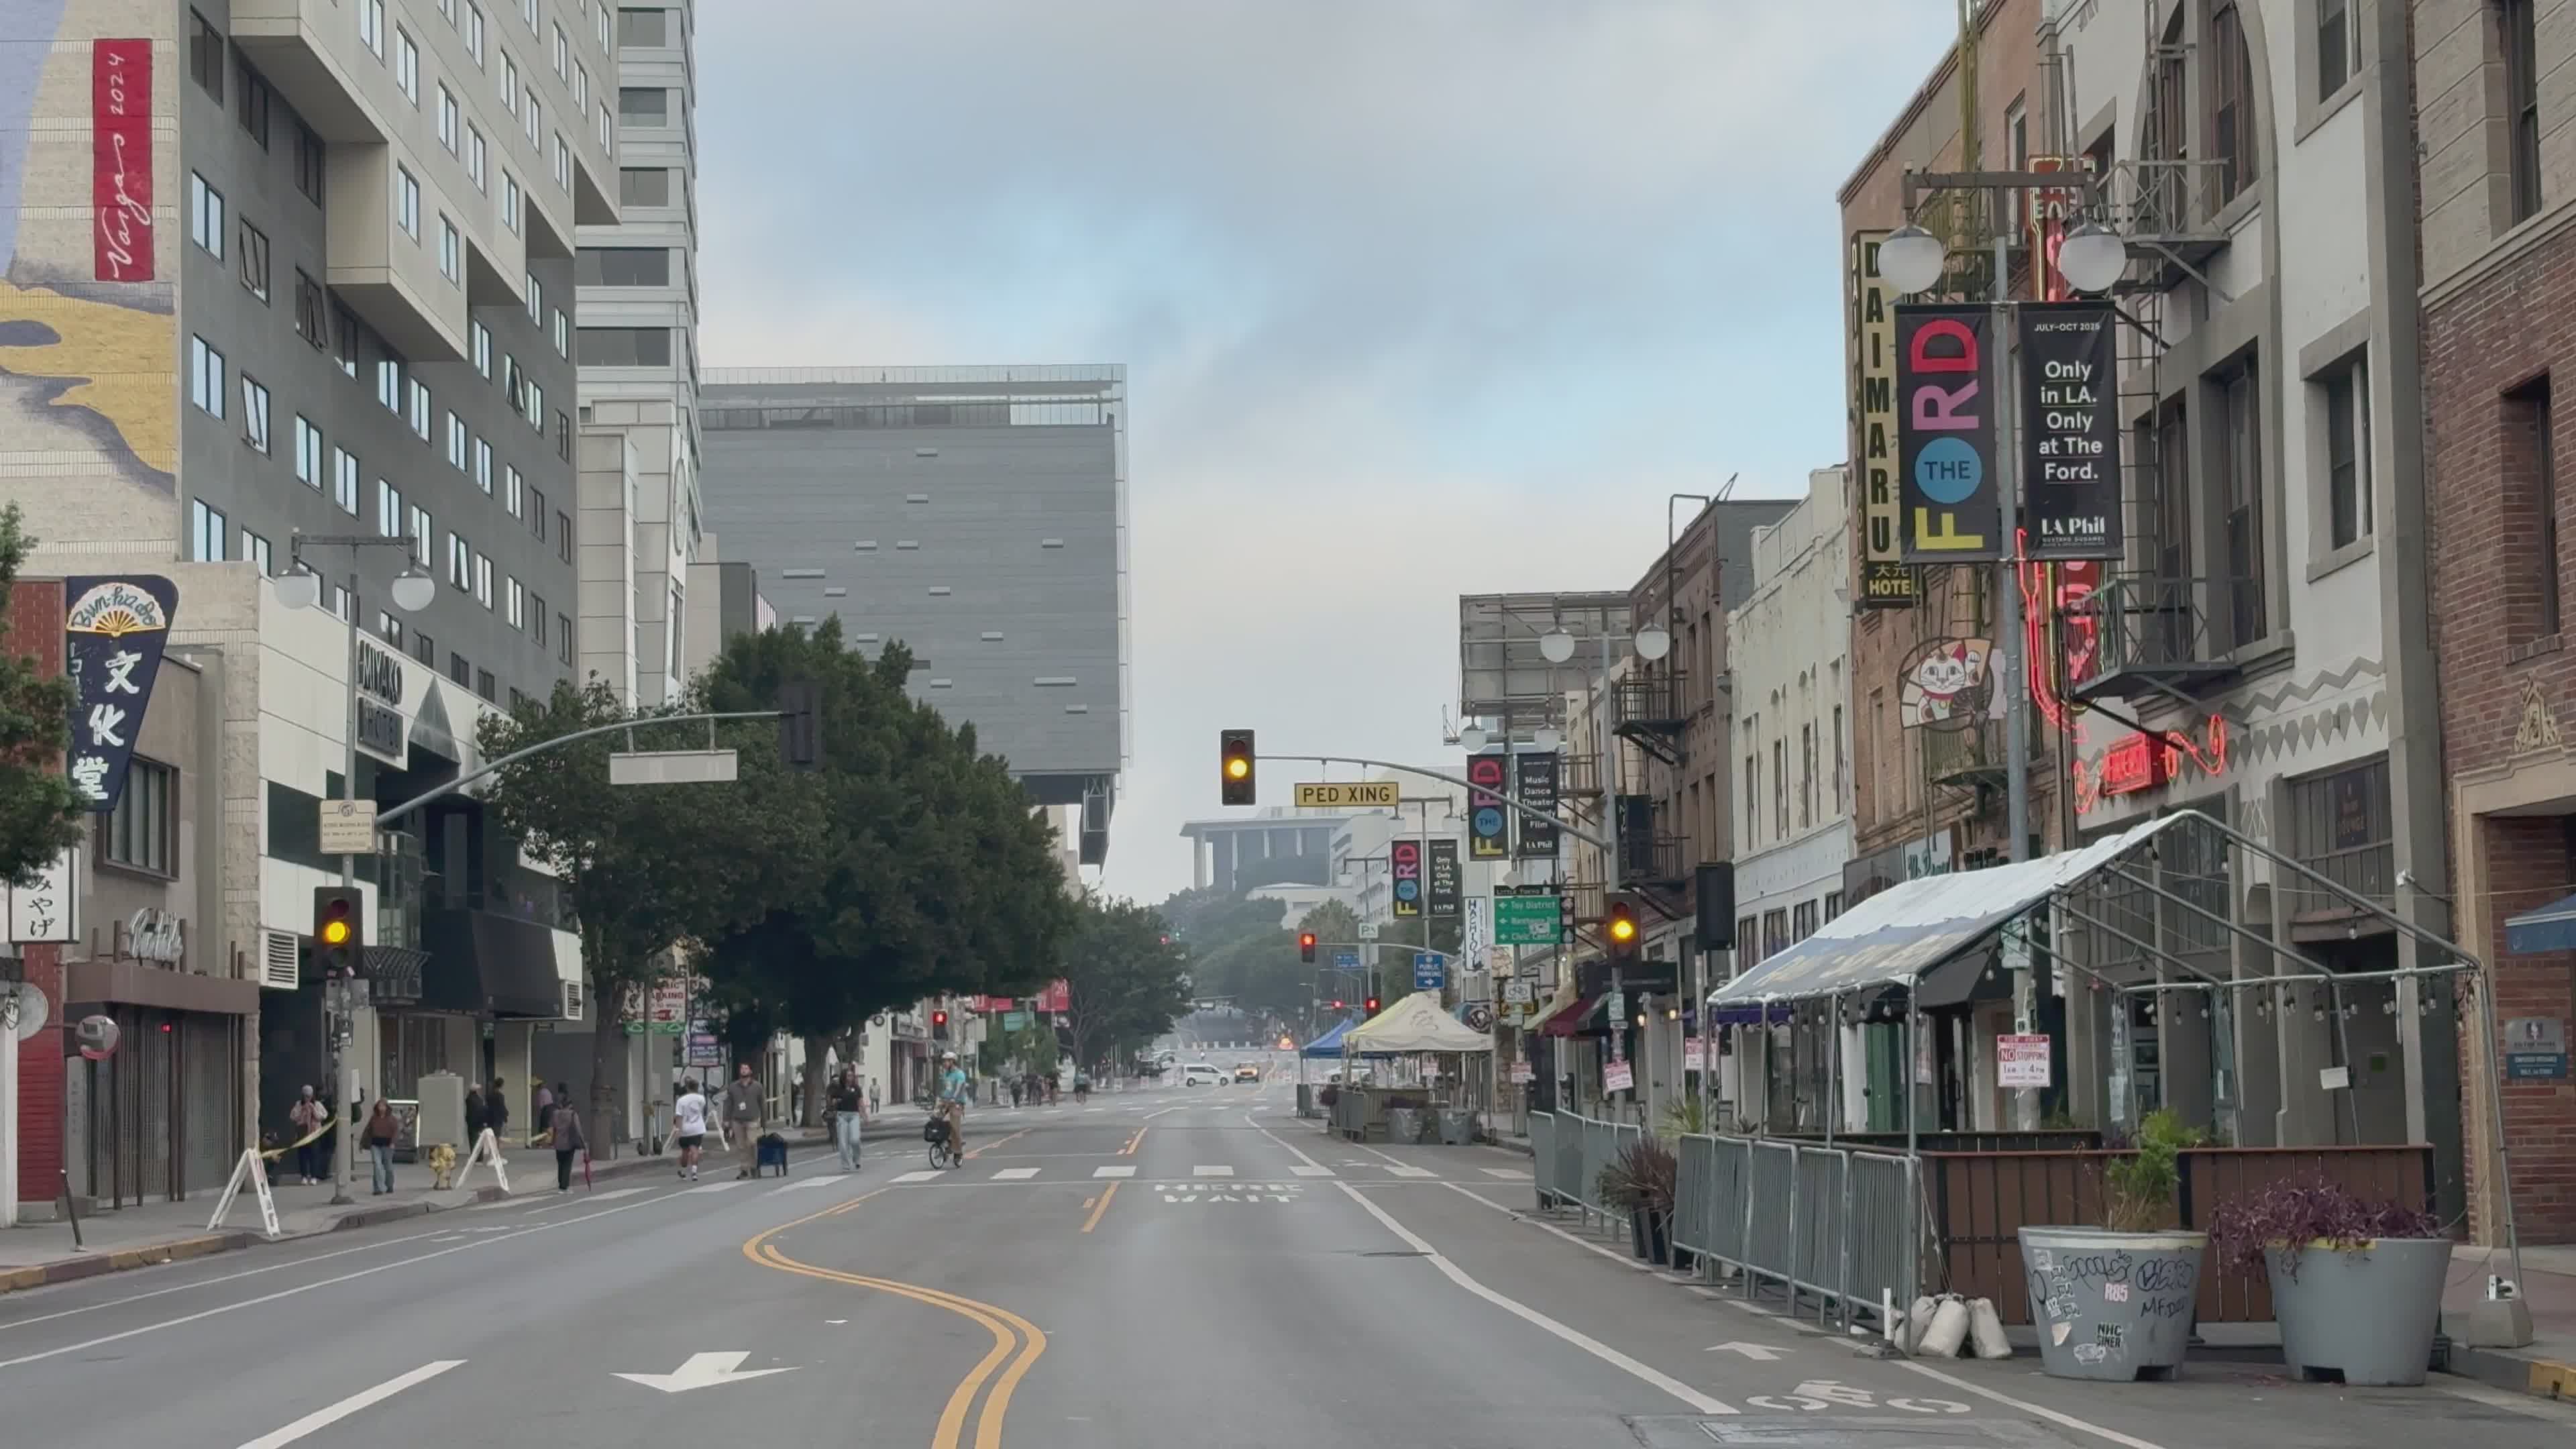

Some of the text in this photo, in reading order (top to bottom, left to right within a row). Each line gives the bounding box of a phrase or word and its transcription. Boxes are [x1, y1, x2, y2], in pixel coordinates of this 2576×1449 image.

[102, 52, 150, 278] Vargas 2024
[2045, 360, 2092, 382] Only
[1864, 241, 1890, 553] DAIMARU
[2041, 386, 2098, 403] in LA.
[2047, 412, 2094, 433] Only
[2039, 437, 2103, 454] at The
[1924, 460, 1972, 480] THE
[2045, 462, 2099, 480] Ford.
[2041, 517, 2105, 535] LA Phil
[72, 649, 143, 800] 文化堂
[1525, 776, 1550, 784] Music
[1303, 786, 1391, 803] PED XING
[1524, 787, 1552, 796] Dance
[1530, 820, 1548, 828] Film
[2000, 1049, 2015, 1061] NO
